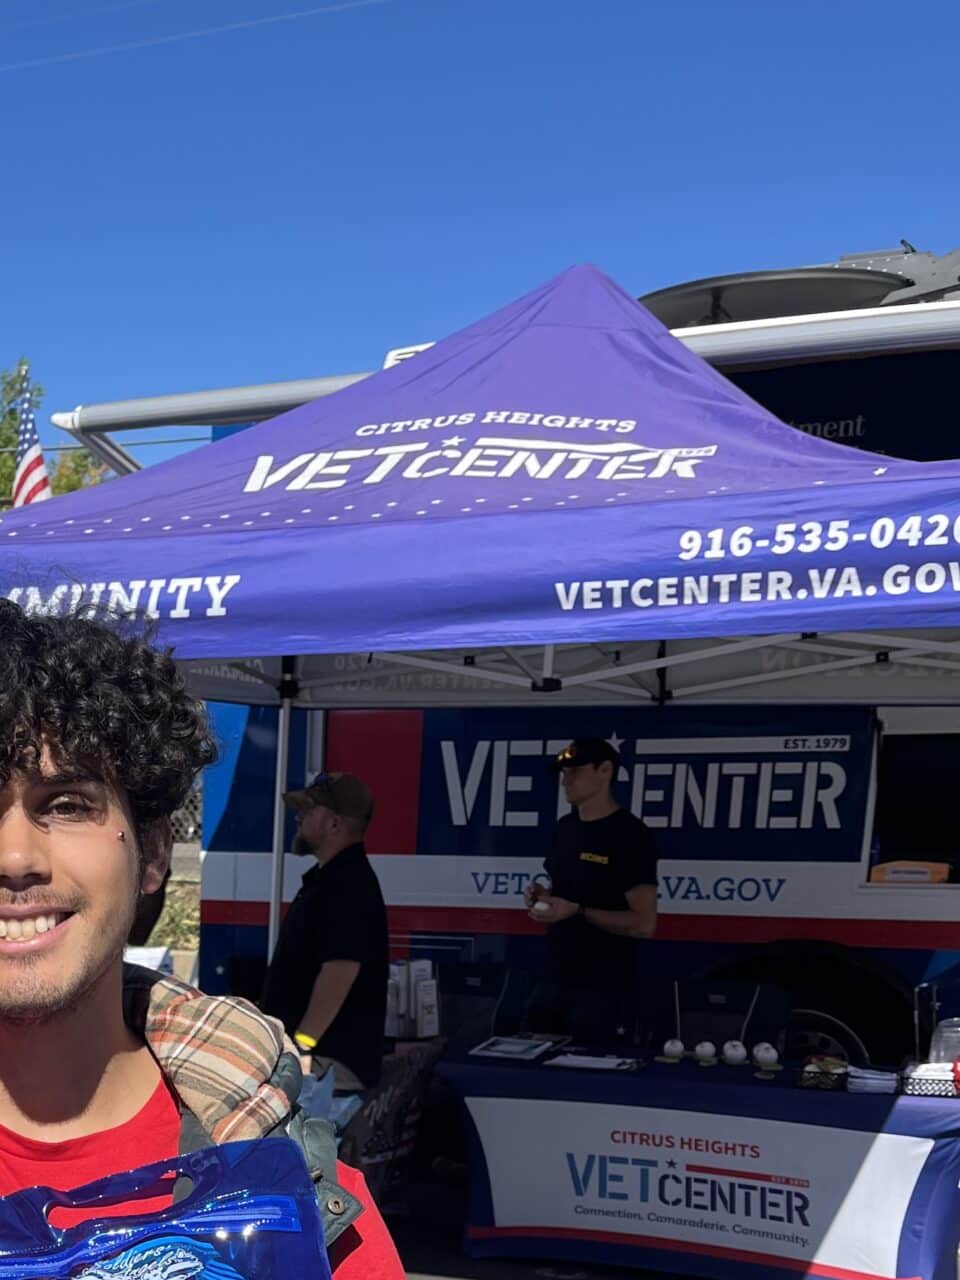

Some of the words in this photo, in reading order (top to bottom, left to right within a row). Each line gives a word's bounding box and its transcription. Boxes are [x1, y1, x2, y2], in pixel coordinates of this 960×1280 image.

[355, 412, 475, 437] CITRUS
[480, 410, 638, 433] HEIGHTS
[783, 738, 811, 749] EST.
[816, 737, 848, 749] 1979
[617, 761, 847, 829] ENTER
[610, 1130, 675, 1149] CITRUS
[680, 1136, 761, 1159] HEIGHTS
[574, 1204, 643, 1221] Connection.
[647, 1211, 729, 1233] Camaraderie.
[732, 1223, 810, 1248] Community.
